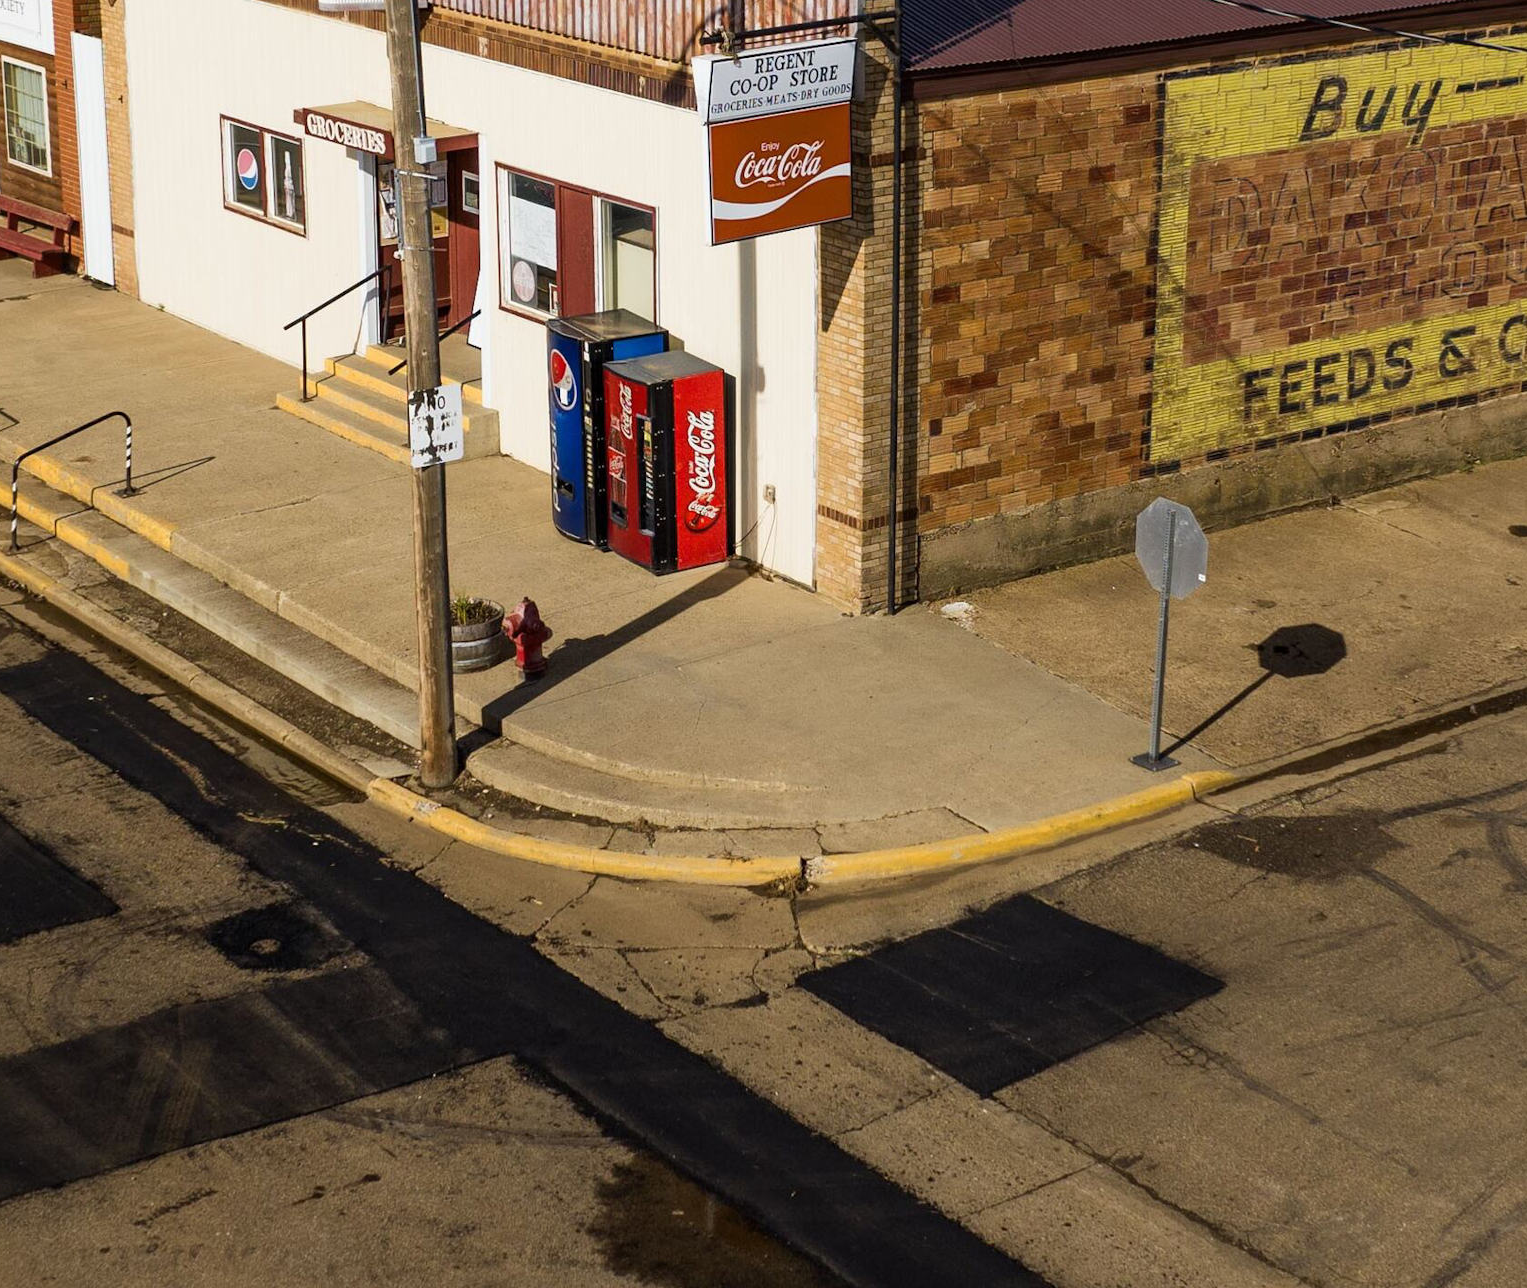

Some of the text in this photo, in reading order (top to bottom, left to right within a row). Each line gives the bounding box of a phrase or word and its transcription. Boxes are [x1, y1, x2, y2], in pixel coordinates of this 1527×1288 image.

[755, 50, 816, 74] REGENT
[730, 65, 839, 96] CO-OP STORE
[822, 82, 852, 96] GOODS
[306, 113, 386, 154] GROCERIES
[761, 142, 780, 152] Enjoy
[735, 140, 825, 188] Coca-Cola
[1240, 338, 1415, 416] FEEDS
[1439, 325, 1476, 378] &
[687, 410, 715, 494] Coca-Cola
